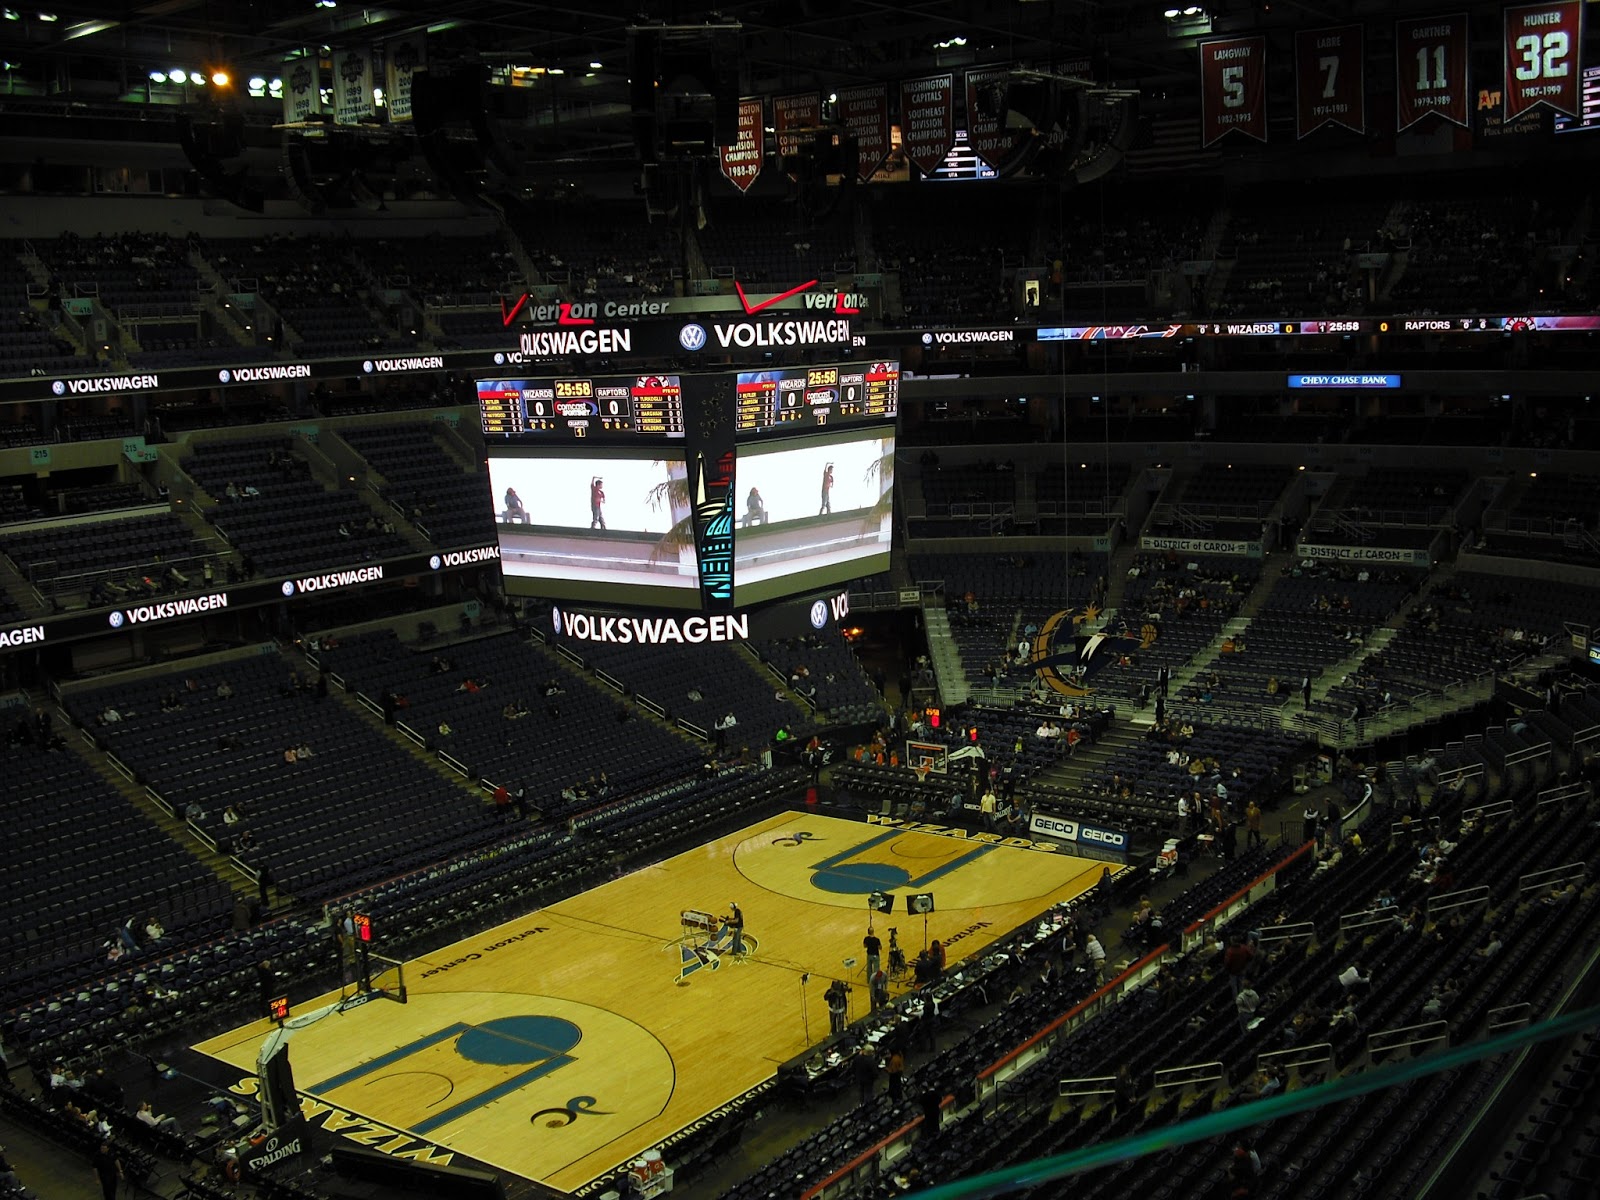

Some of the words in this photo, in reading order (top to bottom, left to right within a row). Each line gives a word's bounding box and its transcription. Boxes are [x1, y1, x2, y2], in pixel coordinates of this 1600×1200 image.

[1524, 12, 1561, 26] HUNTER
[1412, 25, 1452, 39] GARTNER
[1213, 47, 1251, 60] LANGWAY
[1516, 32, 1568, 80] 32
[1416, 45, 1447, 90] 11
[1320, 56, 1339, 98] 7
[903, 78, 950, 93] WASHINGTON
[1222, 66, 1244, 107] 5
[1521, 85, 1561, 98] 1987-1999
[911, 91, 943, 104] CAPITALS
[908, 106, 945, 120] SOUTHEAST
[911, 117, 943, 130] DIVISION
[907, 129, 947, 142] CHAMPIONS
[725, 150, 759, 163] CHAMPIONS
[911, 144, 944, 158] 2000-01
[530, 299, 597, 325] verizon
[605, 301, 670, 318] Center
[1227, 324, 1274, 334] WIZARDS
[1286, 324, 1293, 333] 0
[1329, 322, 1359, 332] 25:58
[1380, 322, 1388, 332] 0
[1405, 321, 1451, 330] RAPTORS
[714, 319, 851, 348] VOLKSWAGEN
[935, 330, 1013, 344] VOLKSWAGEN
[375, 356, 443, 372] VOLKSWAGEN
[232, 365, 311, 383] VOLKSWAGEN
[809, 370, 836, 385] 25:58
[1301, 376, 1328, 385] CHEVY
[1331, 376, 1359, 385] CHASE
[1362, 376, 1387, 385] BANK
[68, 375, 159, 394] VOLKSWAGEN
[557, 381, 591, 397] 25:58
[523, 389, 554, 399] WIZARDS
[598, 389, 627, 397] RAPTORS
[787, 392, 796, 407] 0
[847, 386, 855, 401] 0
[536, 401, 544, 415] 0
[609, 400, 619, 415] 0
[34, 450, 47, 459] 215
[125, 445, 137, 454] 215
[1154, 538, 1190, 551] DISTRICT
[1193, 541, 1201, 550] of
[1204, 542, 1235, 553] CARON
[1311, 547, 1350, 559] DISTRICT
[1354, 549, 1362, 558] of
[1366, 549, 1400, 561] CARON
[297, 566, 383, 594] VOLKSWAGEN
[127, 592, 229, 625] VOLKSWAGEN
[563, 614, 749, 645] VOLKSWAGEN
[866, 814, 1059, 851] WIZARDS
[1035, 818, 1073, 834] GEICO
[1082, 828, 1124, 846] GEICO
[484, 926, 550, 952] Verizon
[420, 953, 482, 979] Center
[249, 1138, 301, 1171] SPALDING
